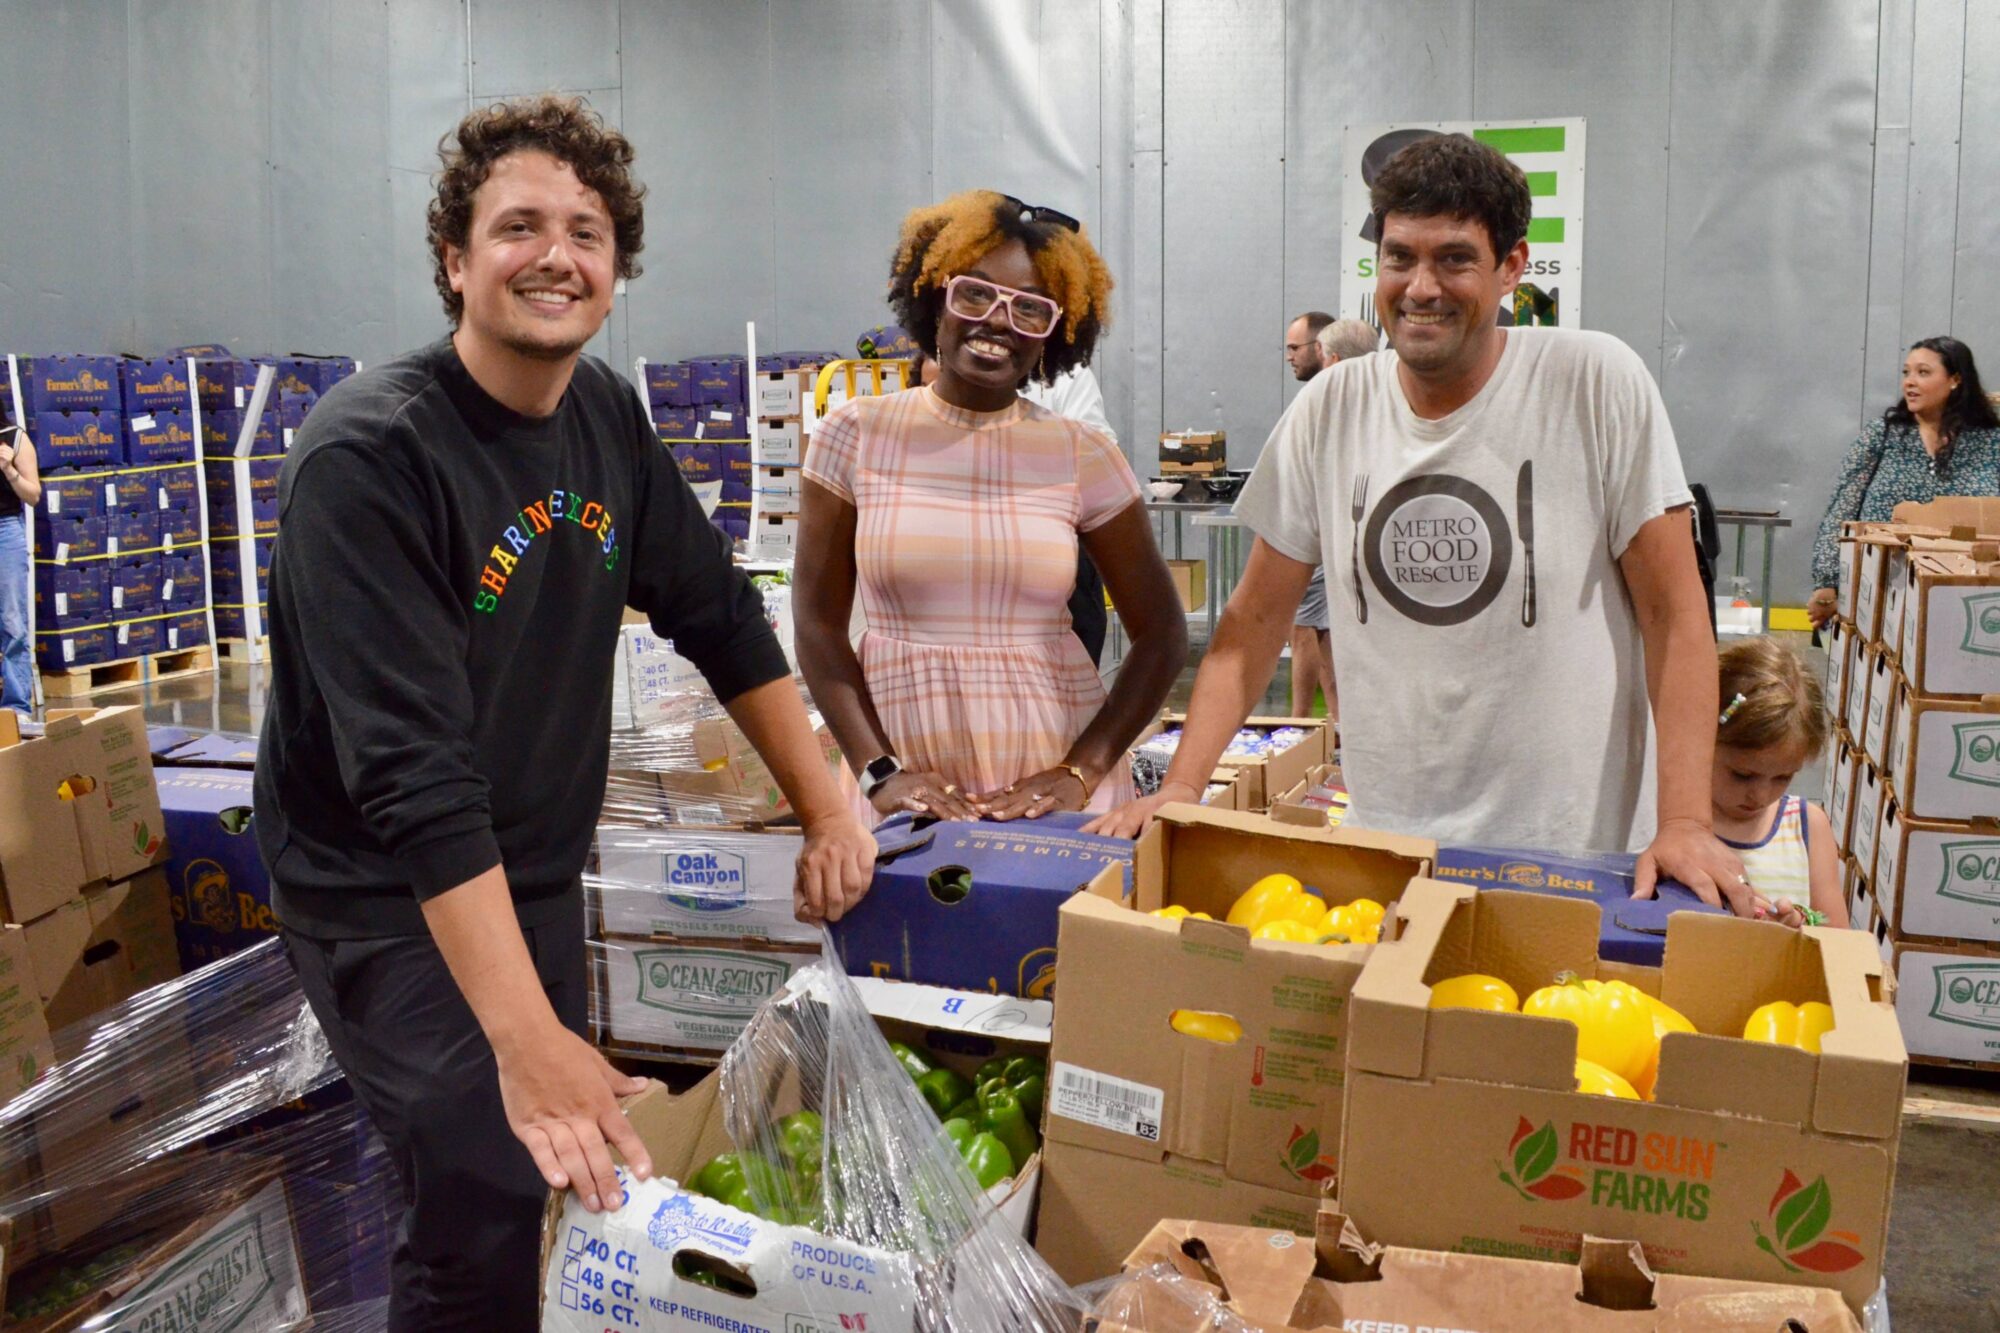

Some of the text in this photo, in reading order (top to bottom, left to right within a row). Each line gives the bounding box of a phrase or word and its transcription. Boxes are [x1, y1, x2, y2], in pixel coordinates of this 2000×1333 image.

[1392, 516, 1477, 538] METRO
[474, 497, 554, 614] SHARIN
[1392, 538, 1478, 564] FOOD
[1395, 564, 1480, 584] RESCUE
[677, 853, 719, 871] Oak
[955, 839, 1133, 867] CUCUMBERS
[671, 869, 740, 885] Canyon
[1437, 865, 1595, 892] mer's Best
[649, 961, 716, 992] OCEAN
[1569, 1122, 1716, 1180] RED SUN
[1590, 1169, 1711, 1222] FARMS
[584, 1236, 641, 1277] 40 CT.
[791, 1240, 877, 1275] PRODUCE
[580, 1265, 640, 1304] 48 CT.
[792, 1263, 874, 1296] OF U.S.A.
[579, 1294, 641, 1328] 56 CT.
[649, 1296, 679, 1316] KEEP
